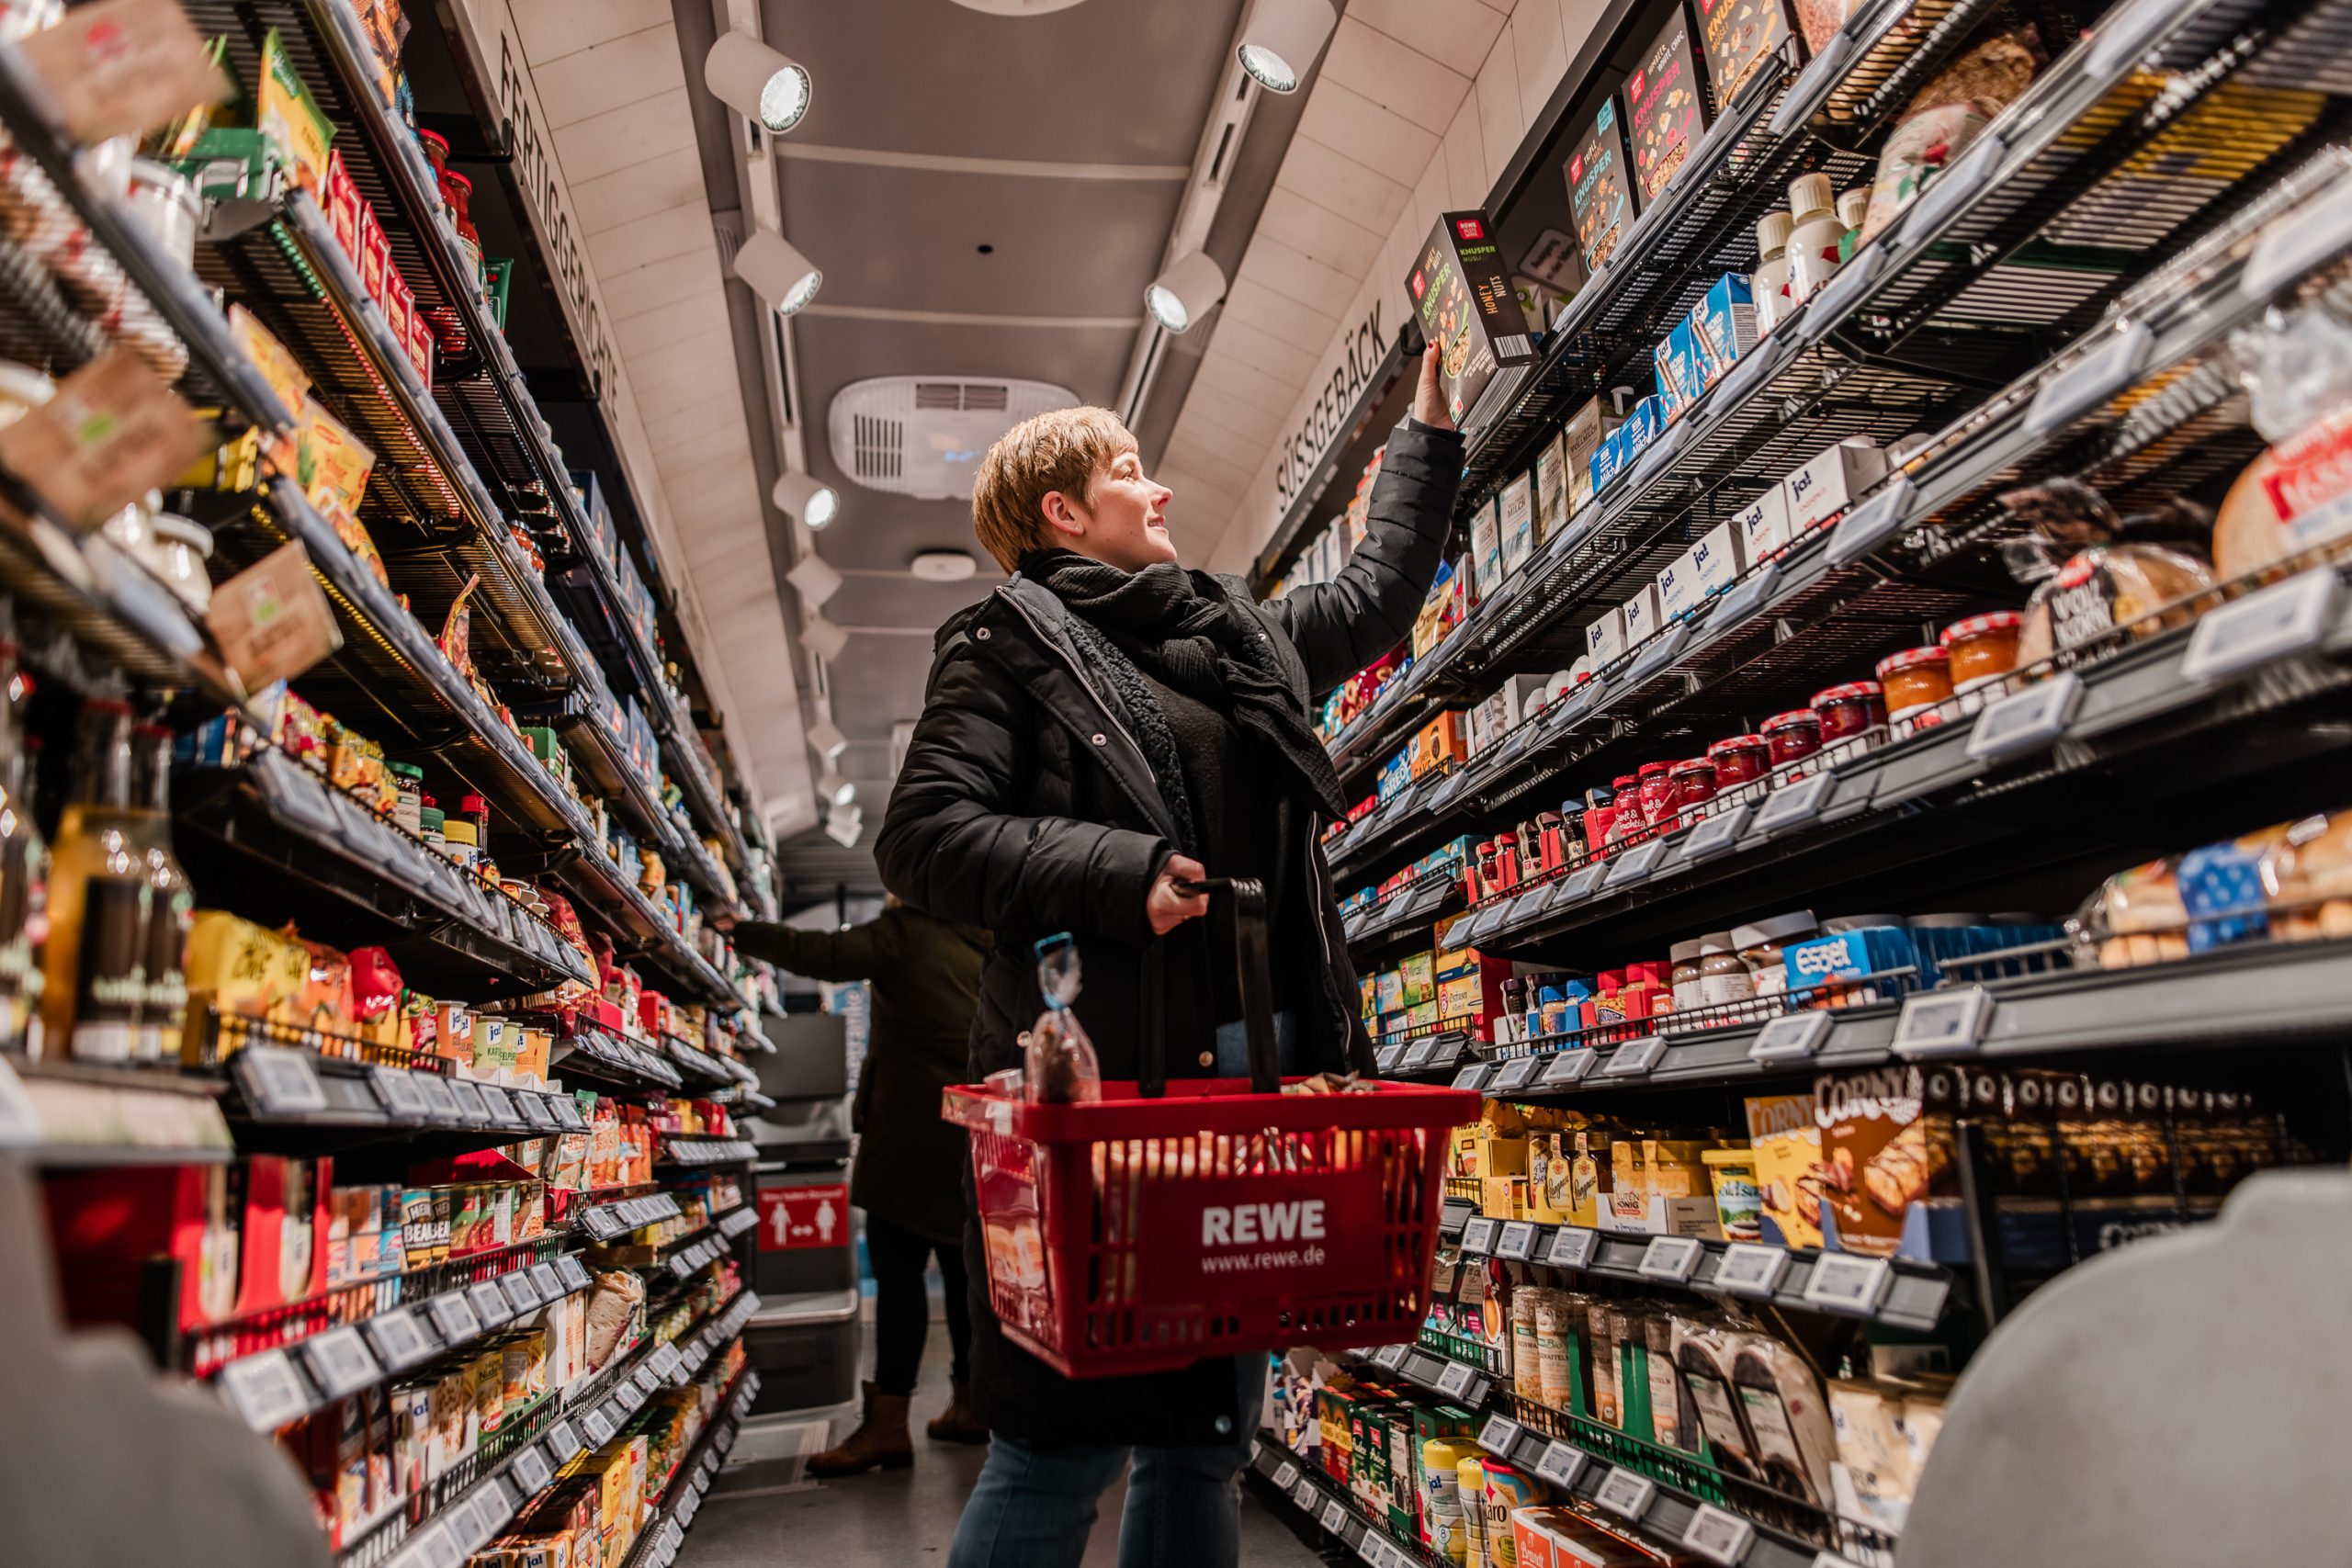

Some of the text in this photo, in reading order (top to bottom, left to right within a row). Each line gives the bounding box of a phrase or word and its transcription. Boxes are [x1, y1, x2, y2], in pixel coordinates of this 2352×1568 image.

[1634, 61, 1680, 130] KNUSPER
[1575, 150, 1611, 208] KNUSPER
[501, 29, 618, 422] FERTIGGERICHTE
[1460, 245, 1496, 255] KNUSPER
[1422, 262, 1452, 320] KNUSPER
[1478, 285, 1499, 315] HONEY
[1489, 276, 1508, 298] NUTS
[1276, 299, 1385, 513] SÜSSGEBÄCK
[1570, 424, 1598, 453] VOLLMILCH
[1632, 434, 1649, 456] Milch
[1600, 466, 1616, 486] Milch
[1792, 469, 1813, 502] ja!
[1507, 498, 1527, 517] MILCH
[1746, 505, 1763, 536] ja!
[1693, 542, 1710, 571] ja!
[1660, 572, 1676, 597] ja!
[1627, 602, 1640, 627] ja!
[1590, 624, 1603, 649] ja!
[1383, 763, 1407, 799] OREO
[490, 1024, 502, 1040] ja!
[1814, 1066, 1907, 1129] CORNY
[1202, 1200, 1326, 1247] REWE
[1202, 1244, 1325, 1273] www.rewe.de
[413, 1395, 429, 1416] a!
[1428, 1474, 1442, 1495] ja!
[1487, 1505, 1508, 1522] aro
[526, 1554, 543, 1567] ja!
[1521, 1541, 1544, 1567] Brandt
